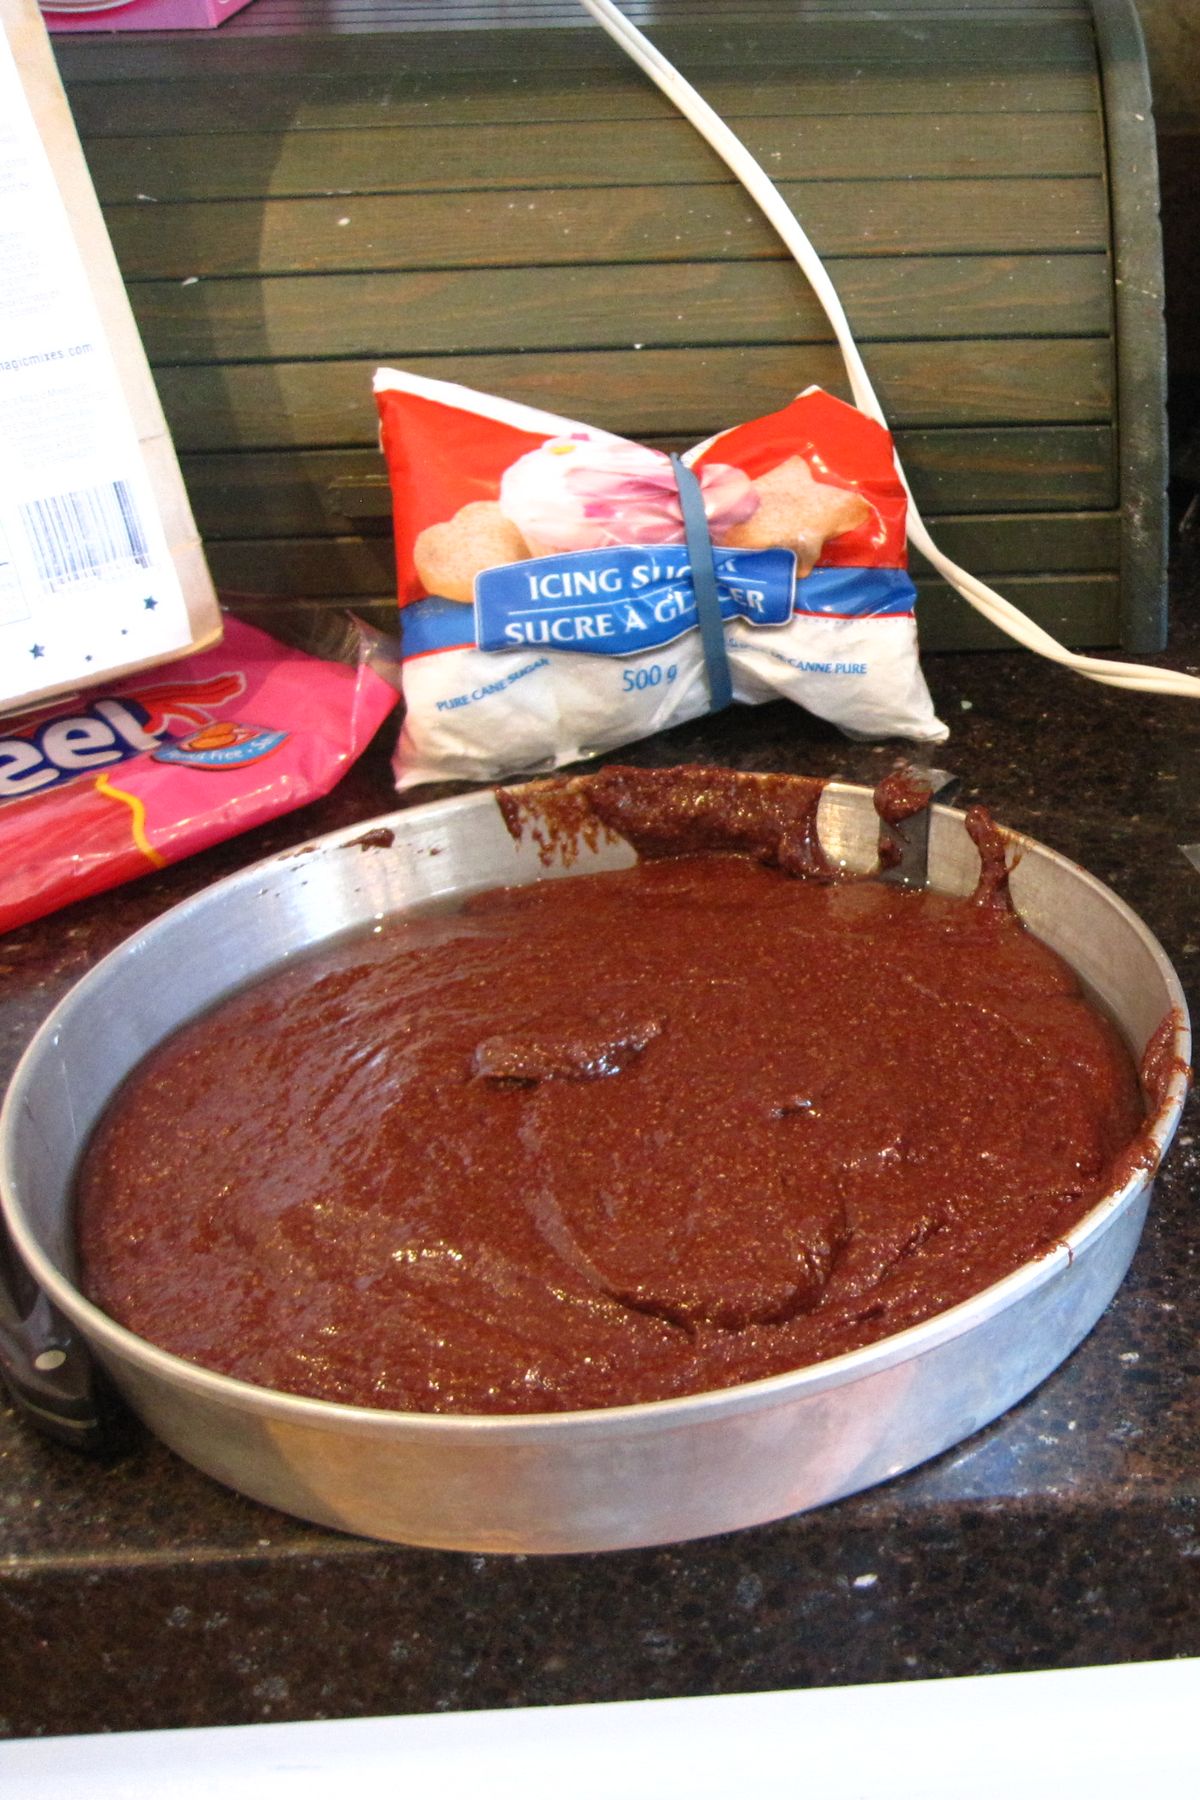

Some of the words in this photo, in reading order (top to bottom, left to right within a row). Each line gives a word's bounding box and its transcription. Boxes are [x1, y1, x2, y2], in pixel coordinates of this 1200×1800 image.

[529, 568, 622, 600] ICING
[631, 558, 737, 590] SUR
[504, 613, 615, 645] SUCRE
[624, 604, 648, 633] À
[654, 588, 765, 623] GLER
[436, 694, 468, 711] PURE
[472, 679, 507, 701] CANE
[507, 656, 551, 683] SUGAR
[623, 664, 662, 692] 500
[667, 664, 677, 684] g
[788, 657, 832, 675] CANNE
[835, 662, 868, 675] PURE
